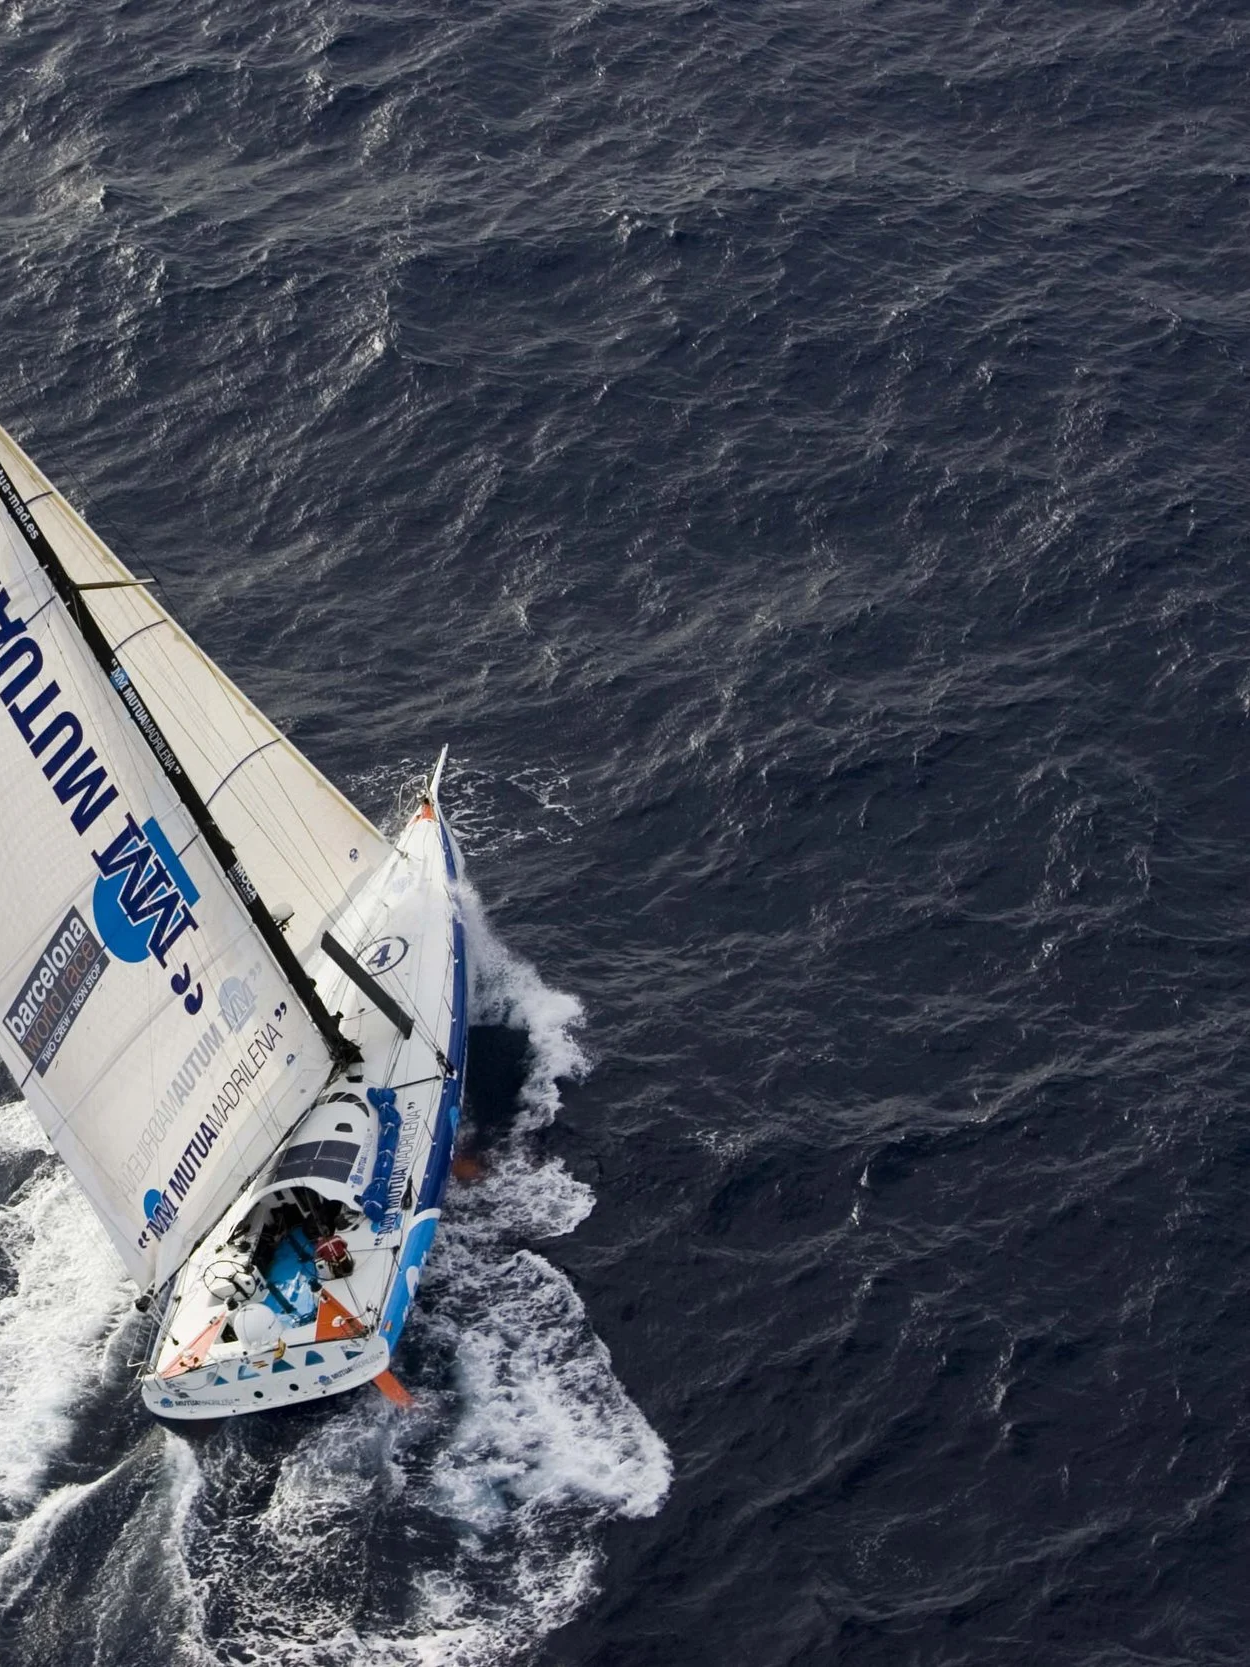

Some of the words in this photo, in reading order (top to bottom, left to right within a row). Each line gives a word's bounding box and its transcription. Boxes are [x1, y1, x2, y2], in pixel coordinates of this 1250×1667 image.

[5, 916, 86, 1041] barcelona
[24, 990, 65, 1057] world
[61, 940, 95, 995] race
[367, 944, 391, 968] 4
[41, 1041, 56, 1064] TWO
[54, 1016, 71, 1043] CREW
[73, 987, 89, 1011] NON
[85, 963, 101, 991] STOP
